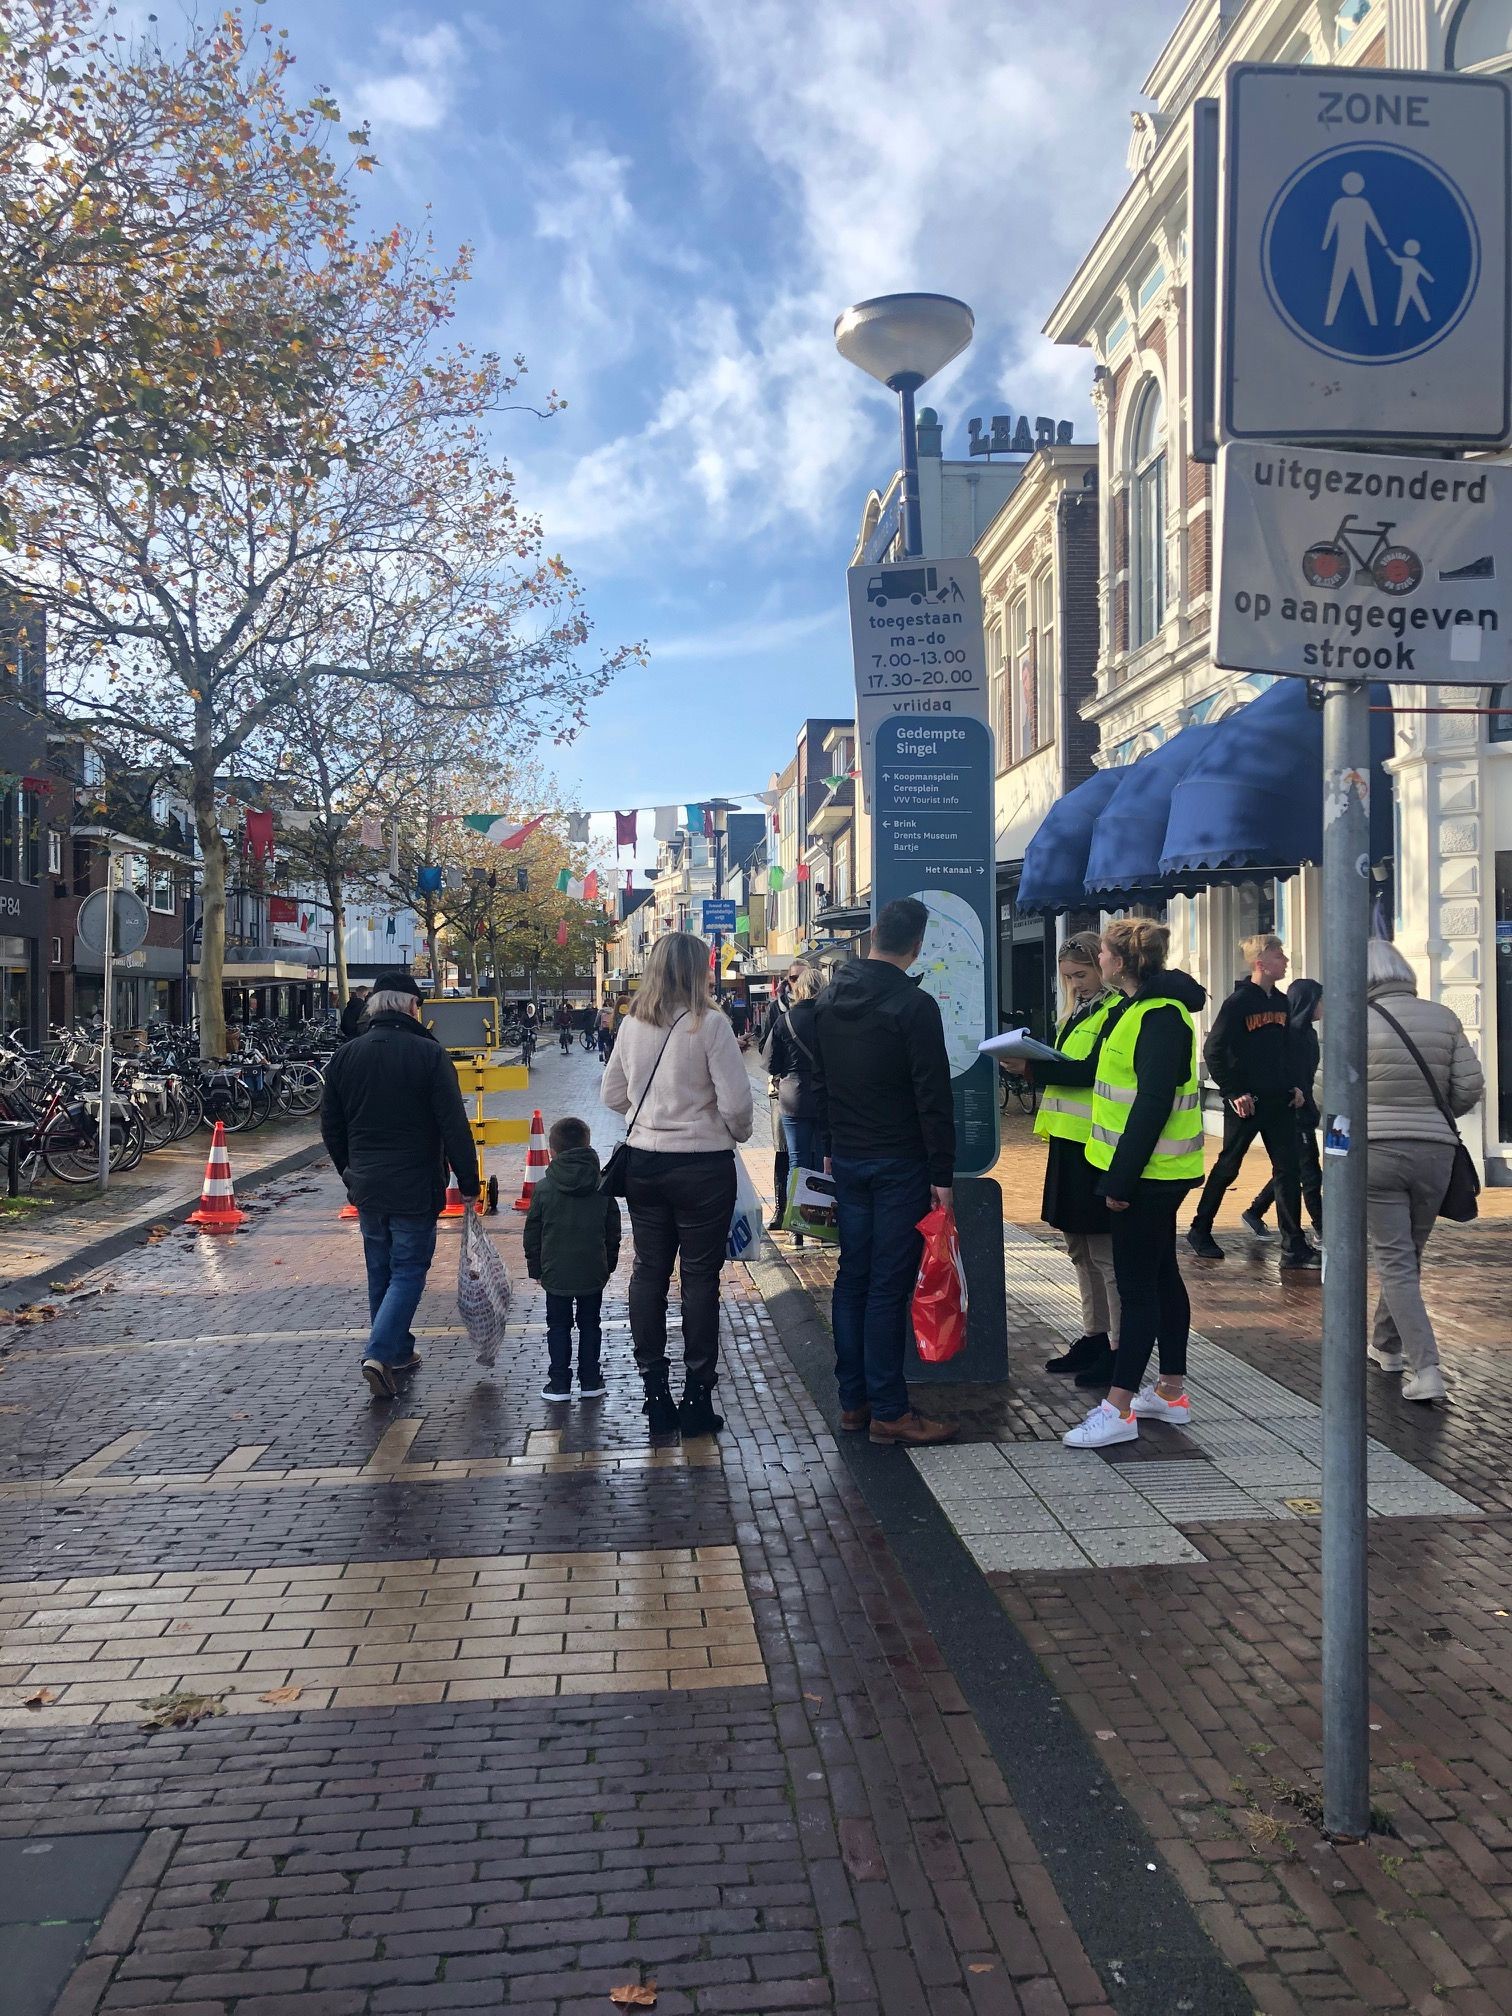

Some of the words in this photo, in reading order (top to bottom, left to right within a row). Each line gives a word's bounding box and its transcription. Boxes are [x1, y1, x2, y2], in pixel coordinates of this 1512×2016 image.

[1317, 92, 1430, 127] ZONE
[1254, 458, 1487, 504] uitgezonderd
[1235, 591, 1271, 621] op
[1282, 596, 1498, 635] aangegeven
[869, 612, 962, 631] toegestaan
[890, 631, 946, 647] ma-do
[872, 649, 966, 668] 7.00-13.00
[1303, 641, 1416, 671] strook
[868, 669, 973, 688] 17.30-20.00
[896, 728, 966, 742] Gedempte
[896, 743, 937, 757] Singel
[893, 773, 959, 782] Koopmansplein
[893, 784, 939, 793] Ceresplein
[893, 796, 910, 804] VVV
[912, 796, 941, 804] Tourist
[943, 796, 959, 804] Info
[893, 820, 917, 828] Brink
[893, 832, 922, 840] Drents
[923, 832, 958, 840] Museum
[893, 843, 919, 852] Bartje
[925, 866, 941, 874] Het
[942, 866, 972, 874] Kanaal
